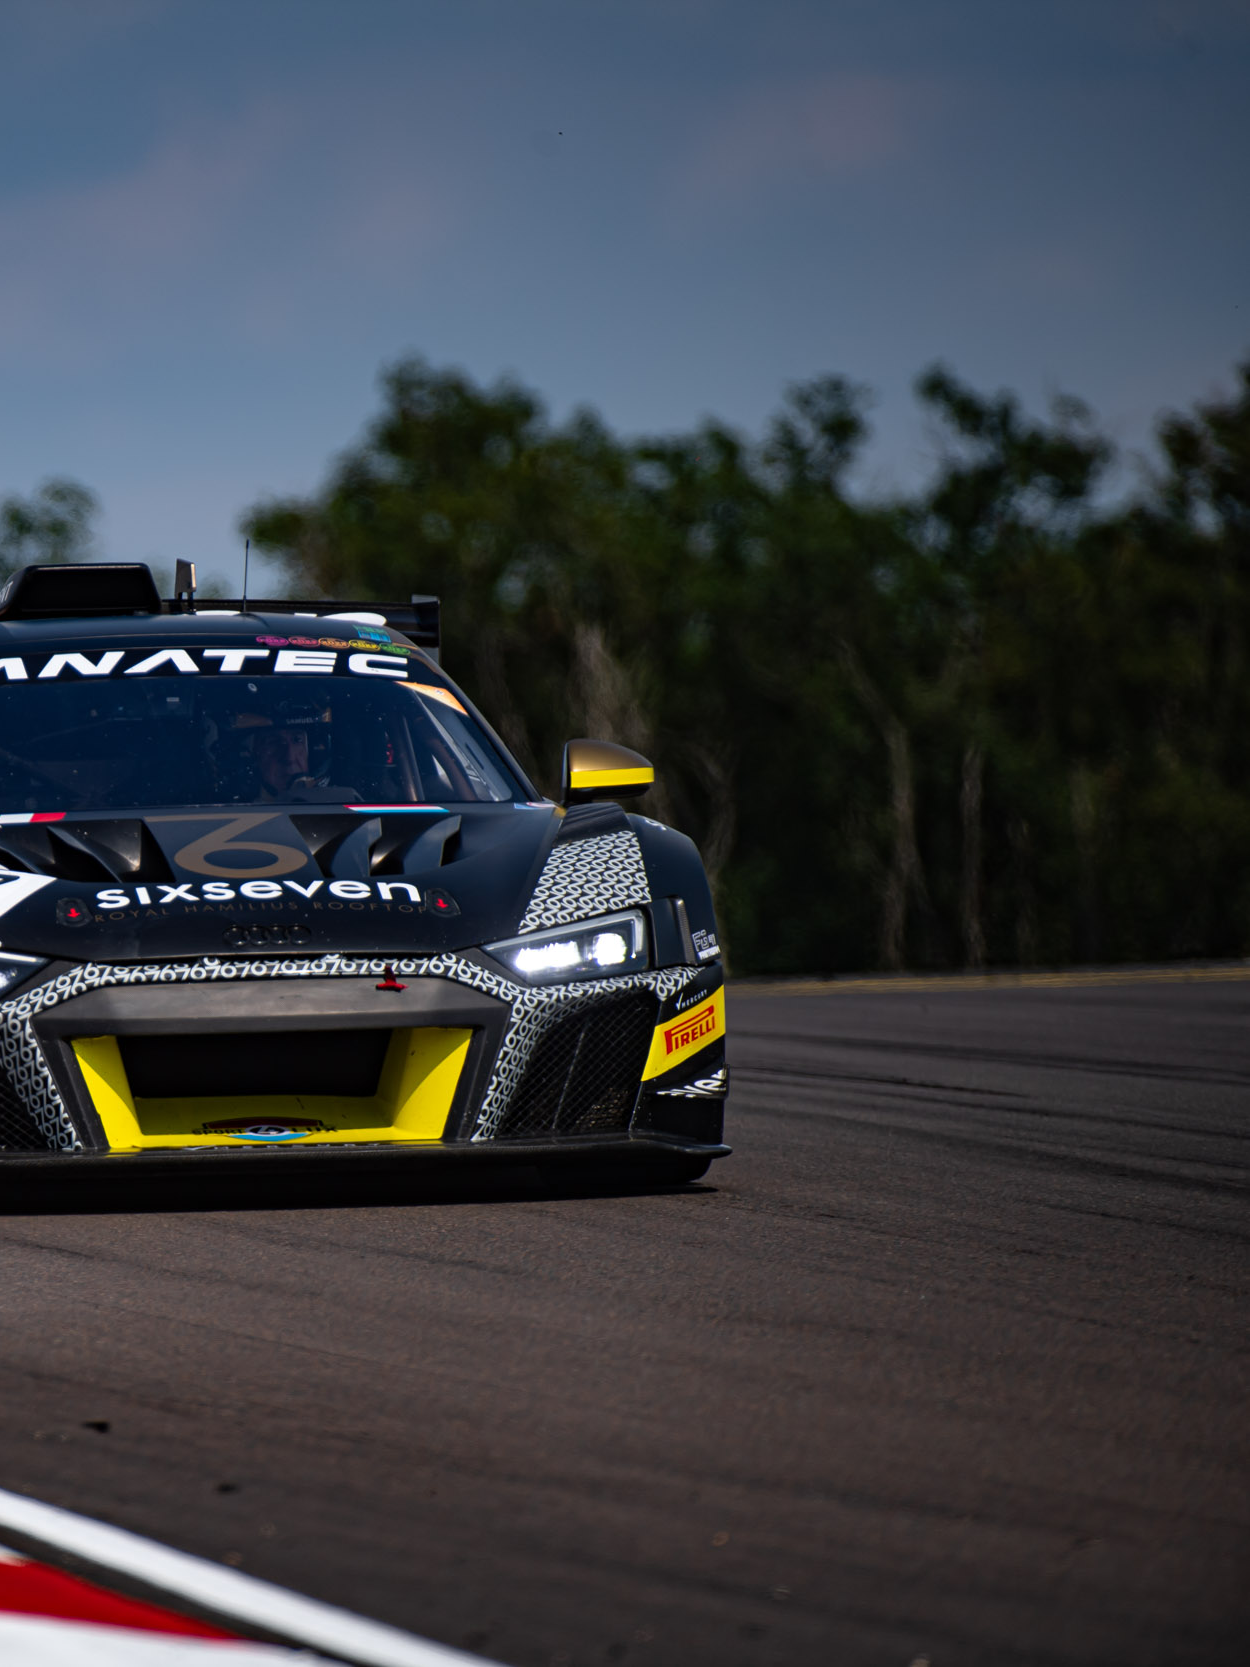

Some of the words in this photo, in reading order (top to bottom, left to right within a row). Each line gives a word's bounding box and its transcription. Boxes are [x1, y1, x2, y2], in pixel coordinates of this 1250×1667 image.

[96, 880, 422, 909] sixseven
[94, 908, 170, 924] ROYAL
[312, 901, 428, 915] ROOFTOP
[664, 1005, 716, 1055] PIRELLI
